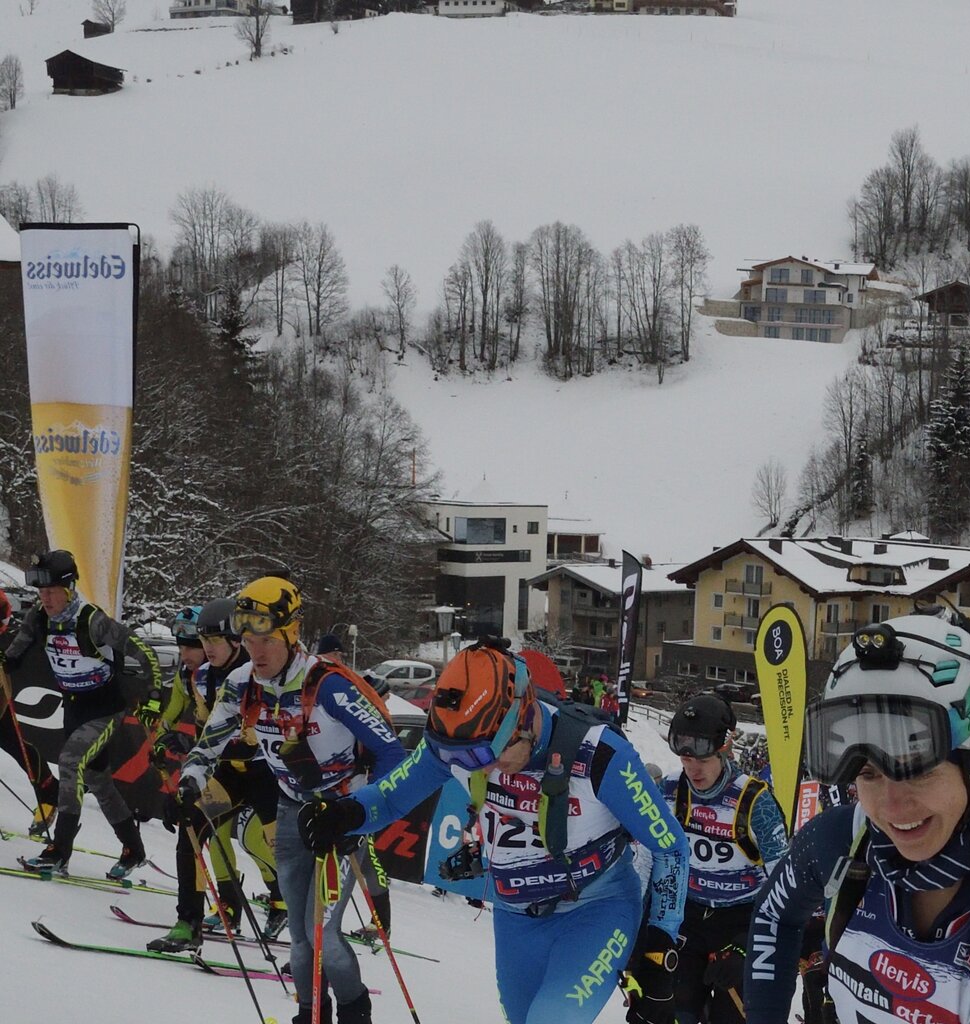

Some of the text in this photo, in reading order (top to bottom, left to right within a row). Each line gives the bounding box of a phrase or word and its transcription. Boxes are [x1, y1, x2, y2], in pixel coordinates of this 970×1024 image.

[772, 626, 784, 660] BOA
[782, 669, 792, 706] DIALED
[345, 701, 396, 743] CRAZY
[776, 672, 791, 741] PRECISION FIT.
[501, 773, 540, 793] Hervis
[620, 761, 677, 849] KARPOS
[689, 837, 734, 864] 09
[510, 867, 598, 888] DENZEL
[698, 877, 749, 890] DENZEL
[565, 928, 628, 1007] KARPOS
[875, 952, 930, 995] Hervis
